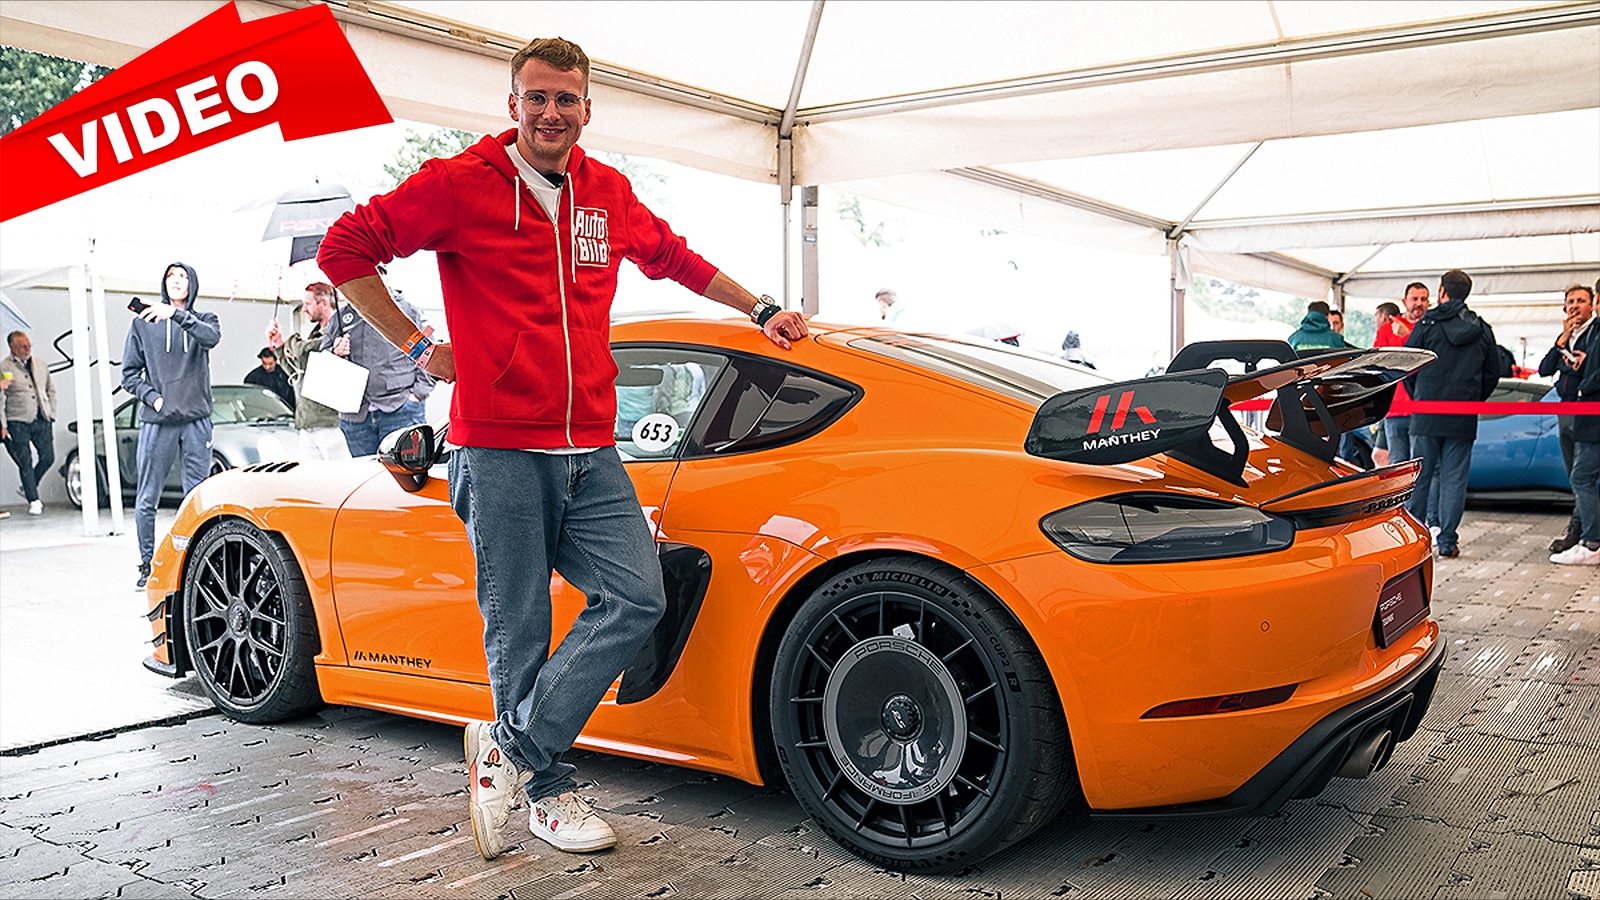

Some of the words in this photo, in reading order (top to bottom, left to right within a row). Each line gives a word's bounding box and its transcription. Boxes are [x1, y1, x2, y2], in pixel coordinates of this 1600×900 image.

[575, 210, 605, 239] Auto
[577, 237, 607, 263] Bild
[640, 422, 672, 442] 653
[1083, 428, 1161, 450] MANTHEY
[872, 572, 945, 594] MICHELIN
[368, 652, 432, 669] MANTHEY
[854, 641, 943, 676] PORSCHE
[840, 755, 941, 800] PERFORMANCE
